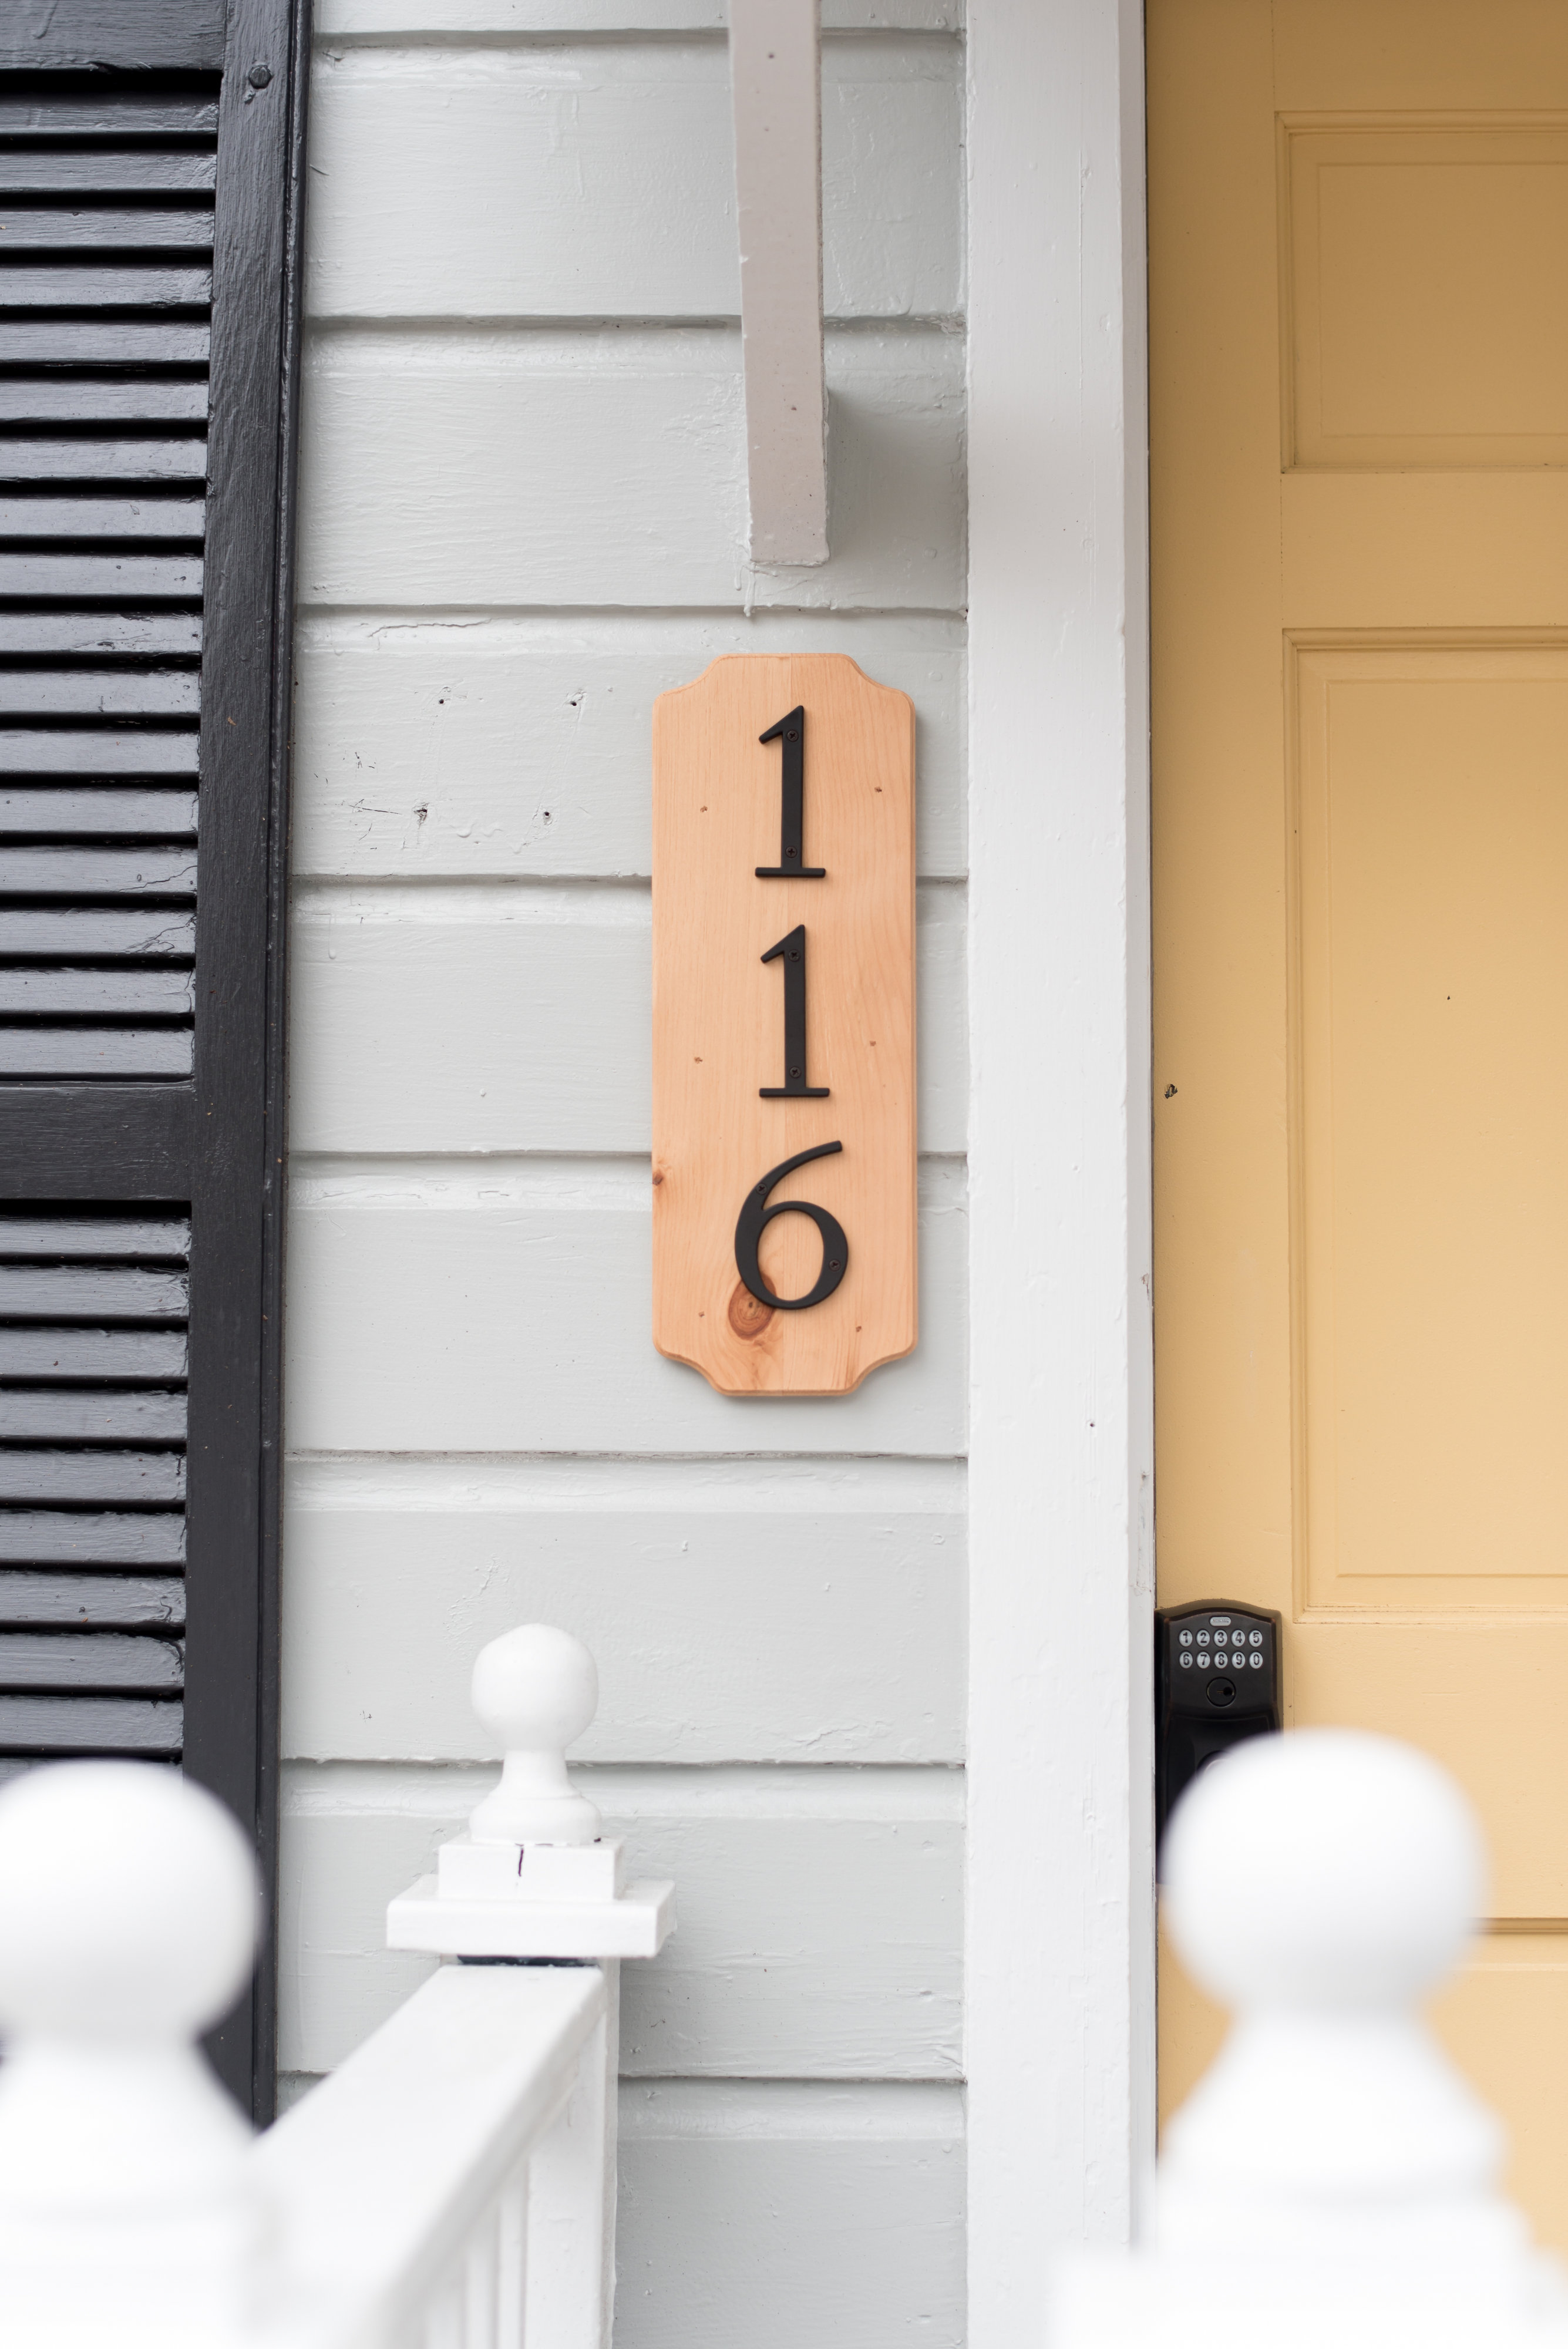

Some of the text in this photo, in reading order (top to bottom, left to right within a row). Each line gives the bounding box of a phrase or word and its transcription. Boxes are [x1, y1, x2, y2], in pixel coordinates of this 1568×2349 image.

[735, 705, 849, 1310] 116
[1182, 1632, 1259, 1643] 1 2 3 4 5
[1183, 1654, 1260, 1665] 6 7 8 9 0
